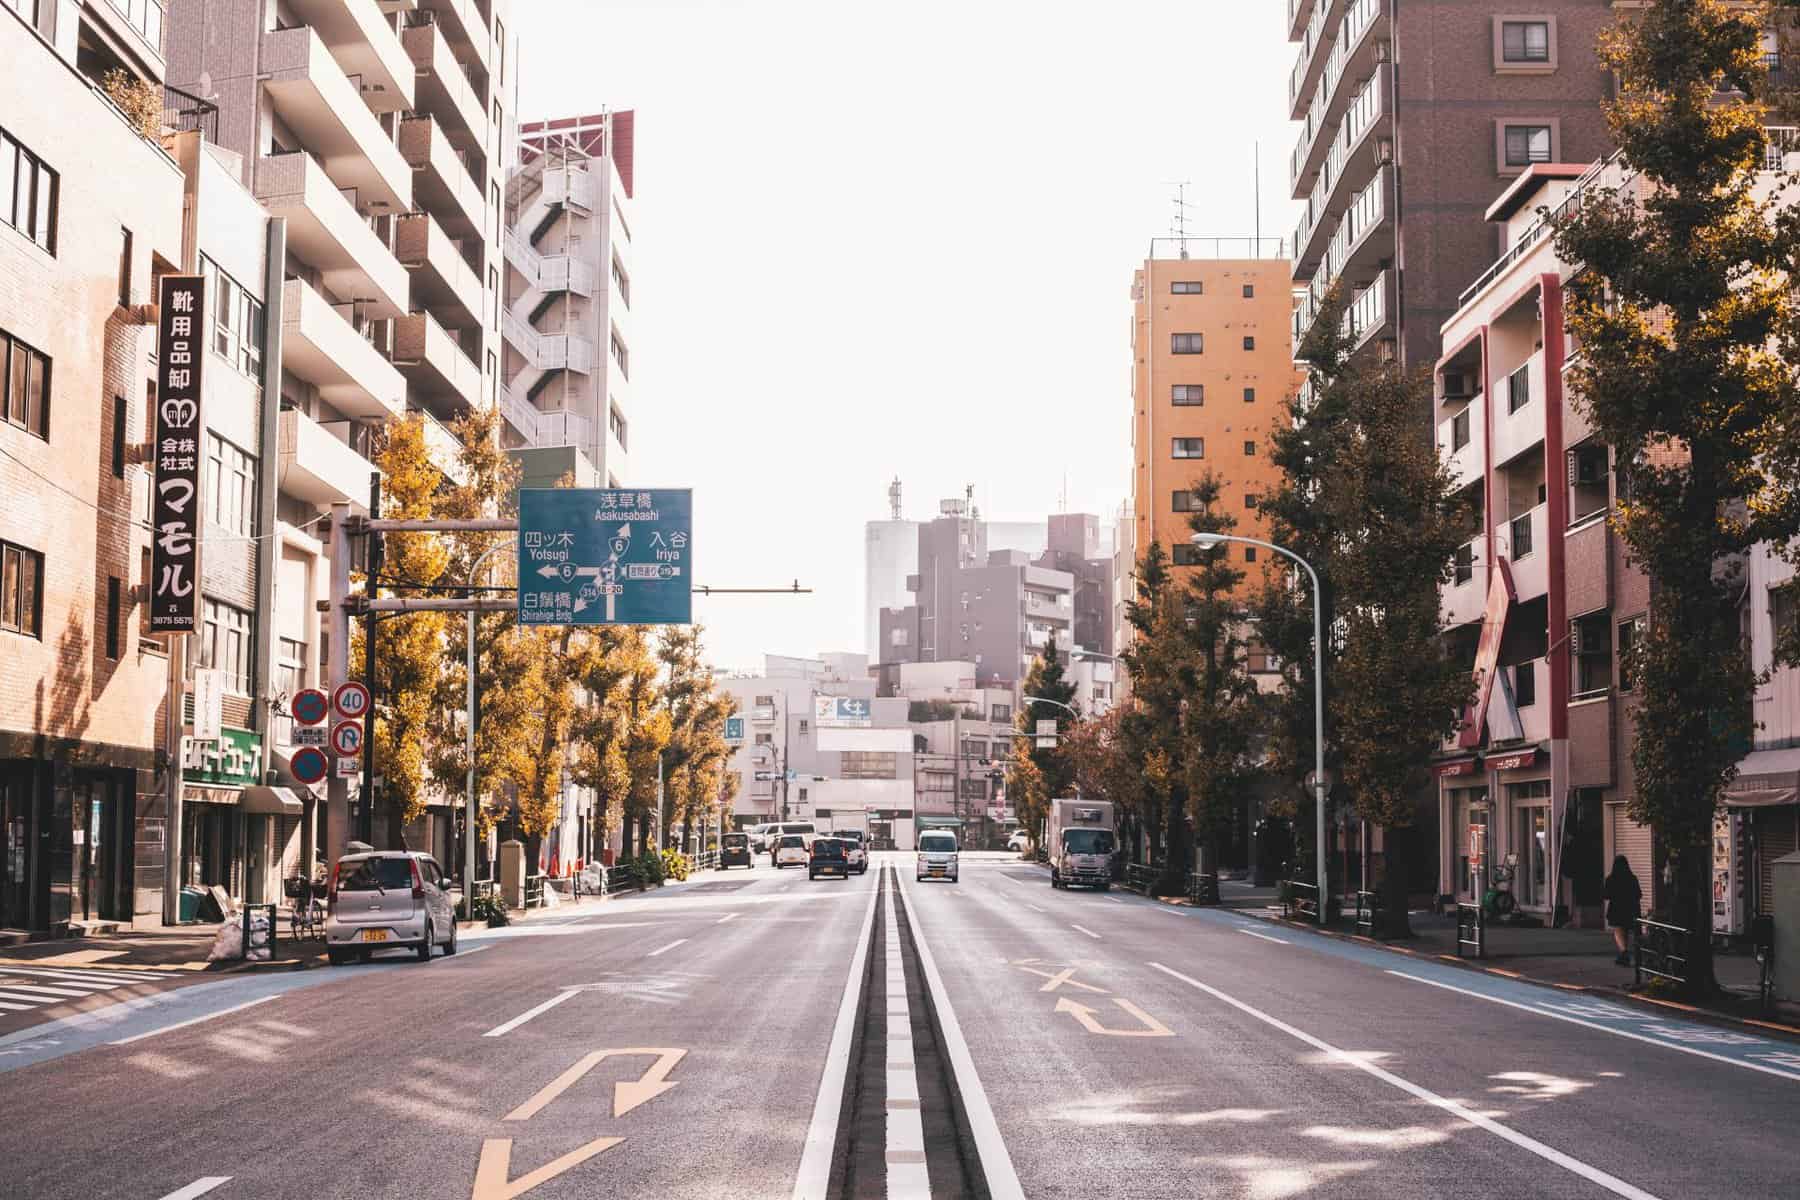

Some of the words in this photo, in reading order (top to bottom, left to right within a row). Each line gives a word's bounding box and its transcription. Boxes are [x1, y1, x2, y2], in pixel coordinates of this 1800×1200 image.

[168, 291, 194, 390] 靴用品卸
[600, 492, 652, 509] 浅草橋
[595, 509, 659, 521] Asakusabashi
[157, 477, 194, 597] マモル
[525, 531, 575, 548] 四ツ木
[649, 531, 688, 549] 入谷
[615, 541, 623, 551] 6
[530, 549, 569, 561] Yotsugi
[656, 549, 680, 562] Iriya
[563, 567, 571, 577] 6
[343, 692, 362, 709] 40
